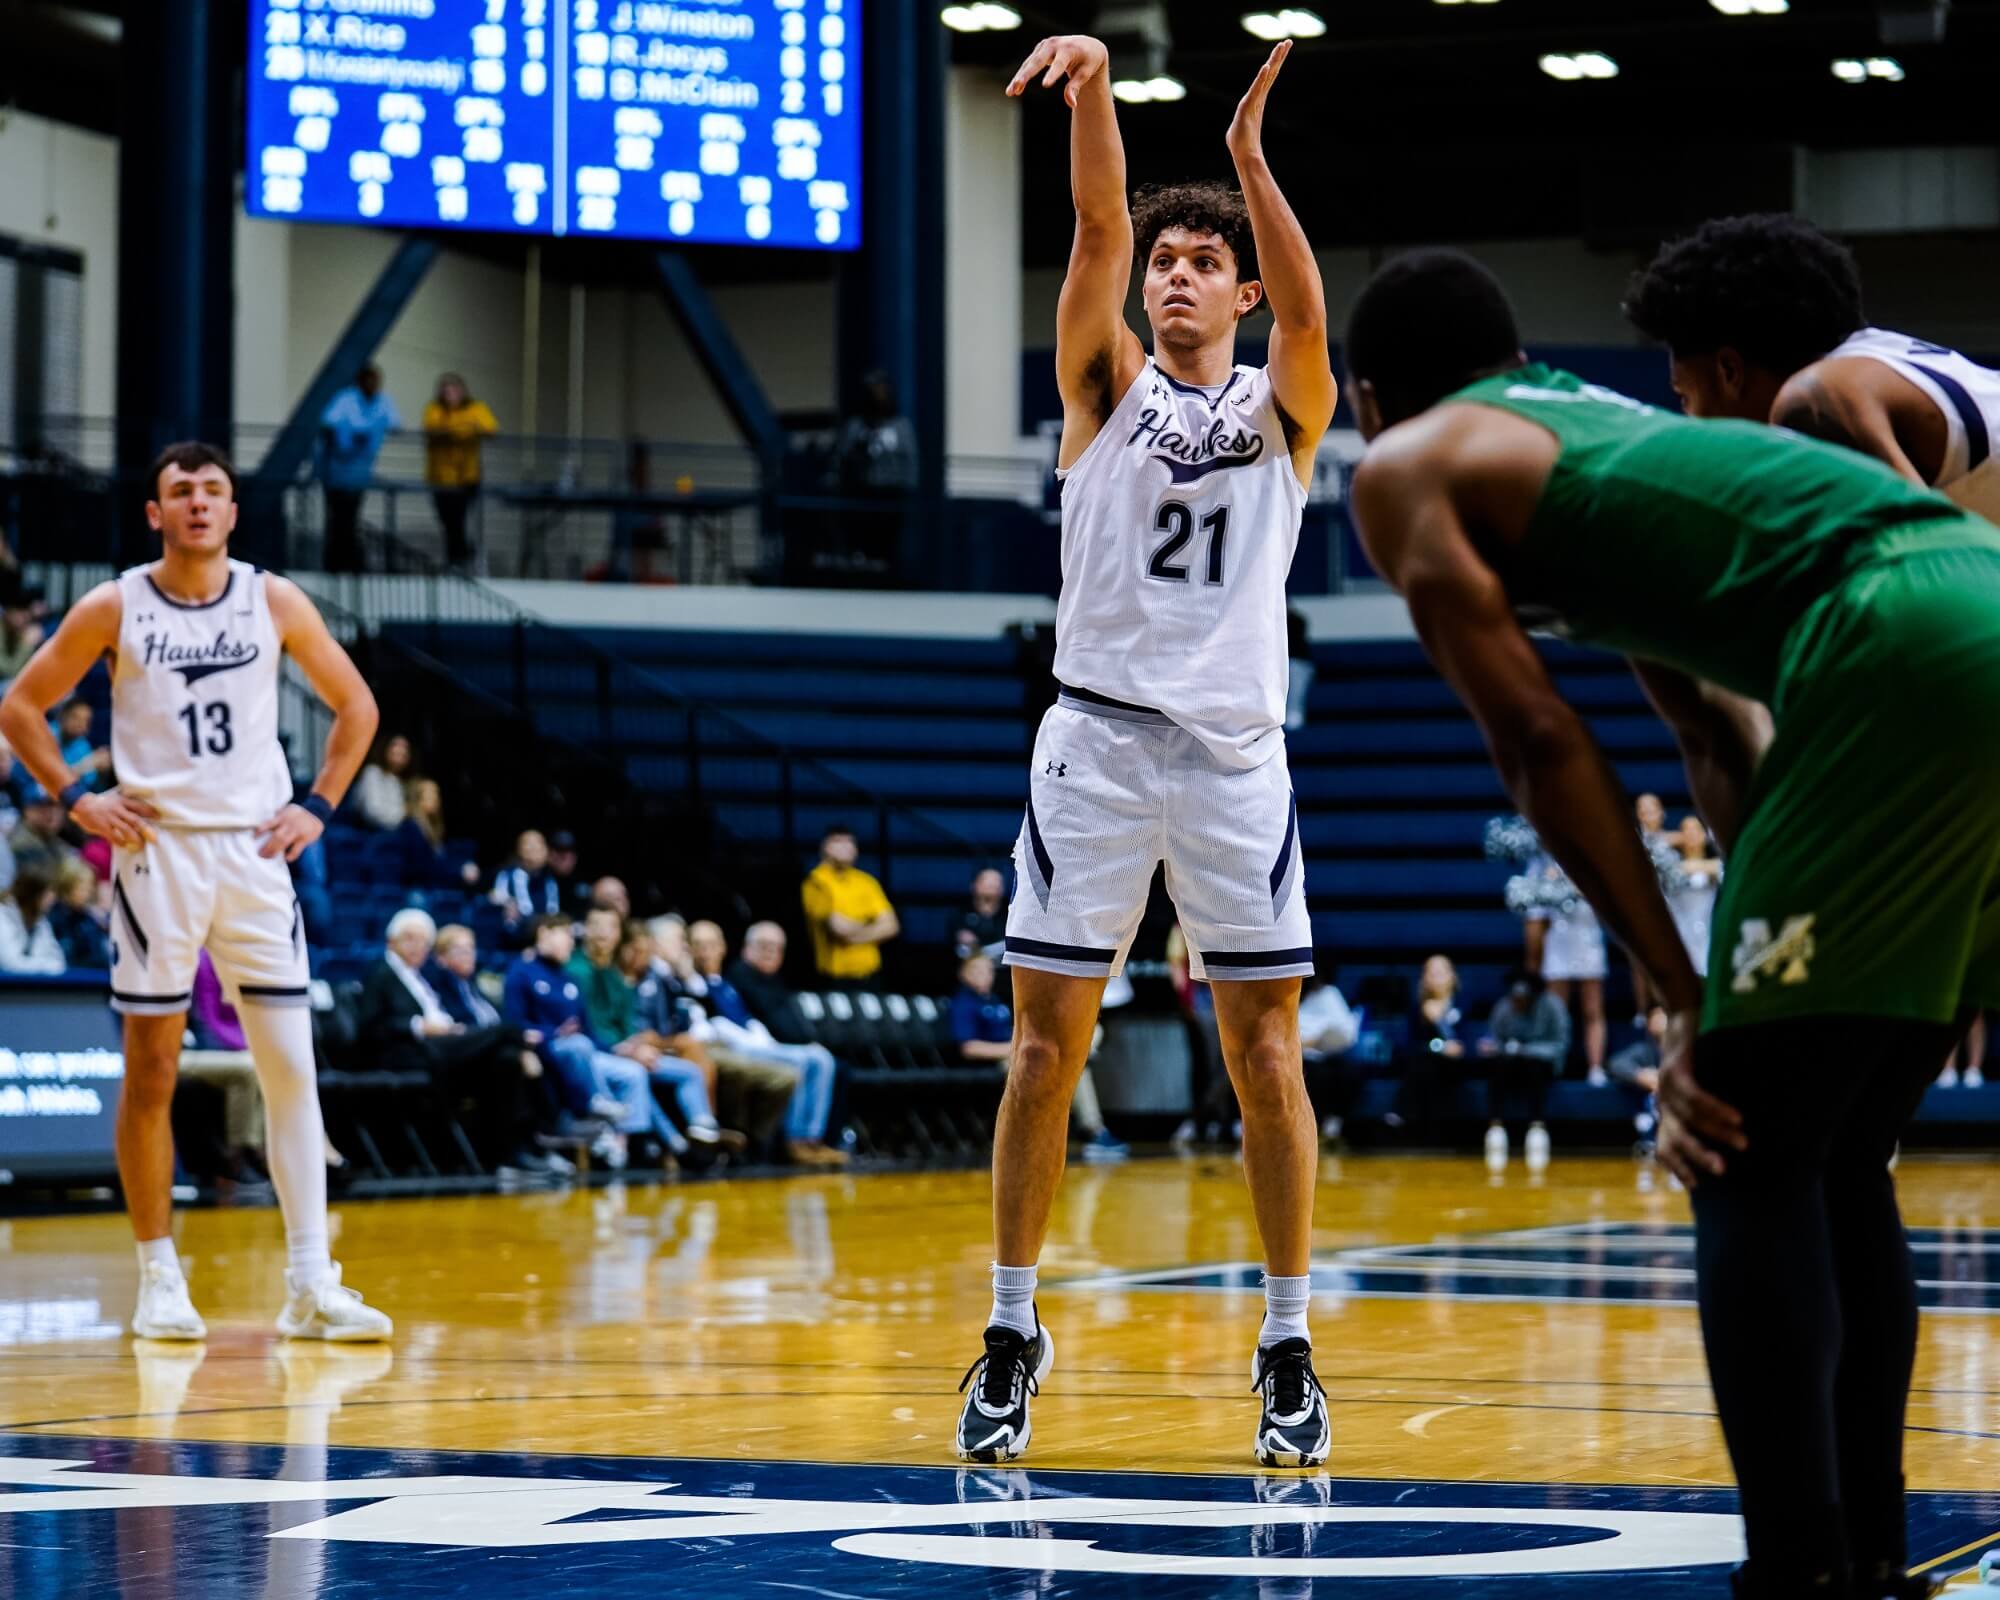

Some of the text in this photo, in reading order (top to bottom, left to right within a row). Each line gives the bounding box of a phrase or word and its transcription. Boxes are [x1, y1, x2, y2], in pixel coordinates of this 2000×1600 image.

[1127, 408, 1260, 466] Hawks
[1145, 499, 1231, 586] 21
[144, 630, 257, 670] Hawks
[178, 701, 234, 757] 13
